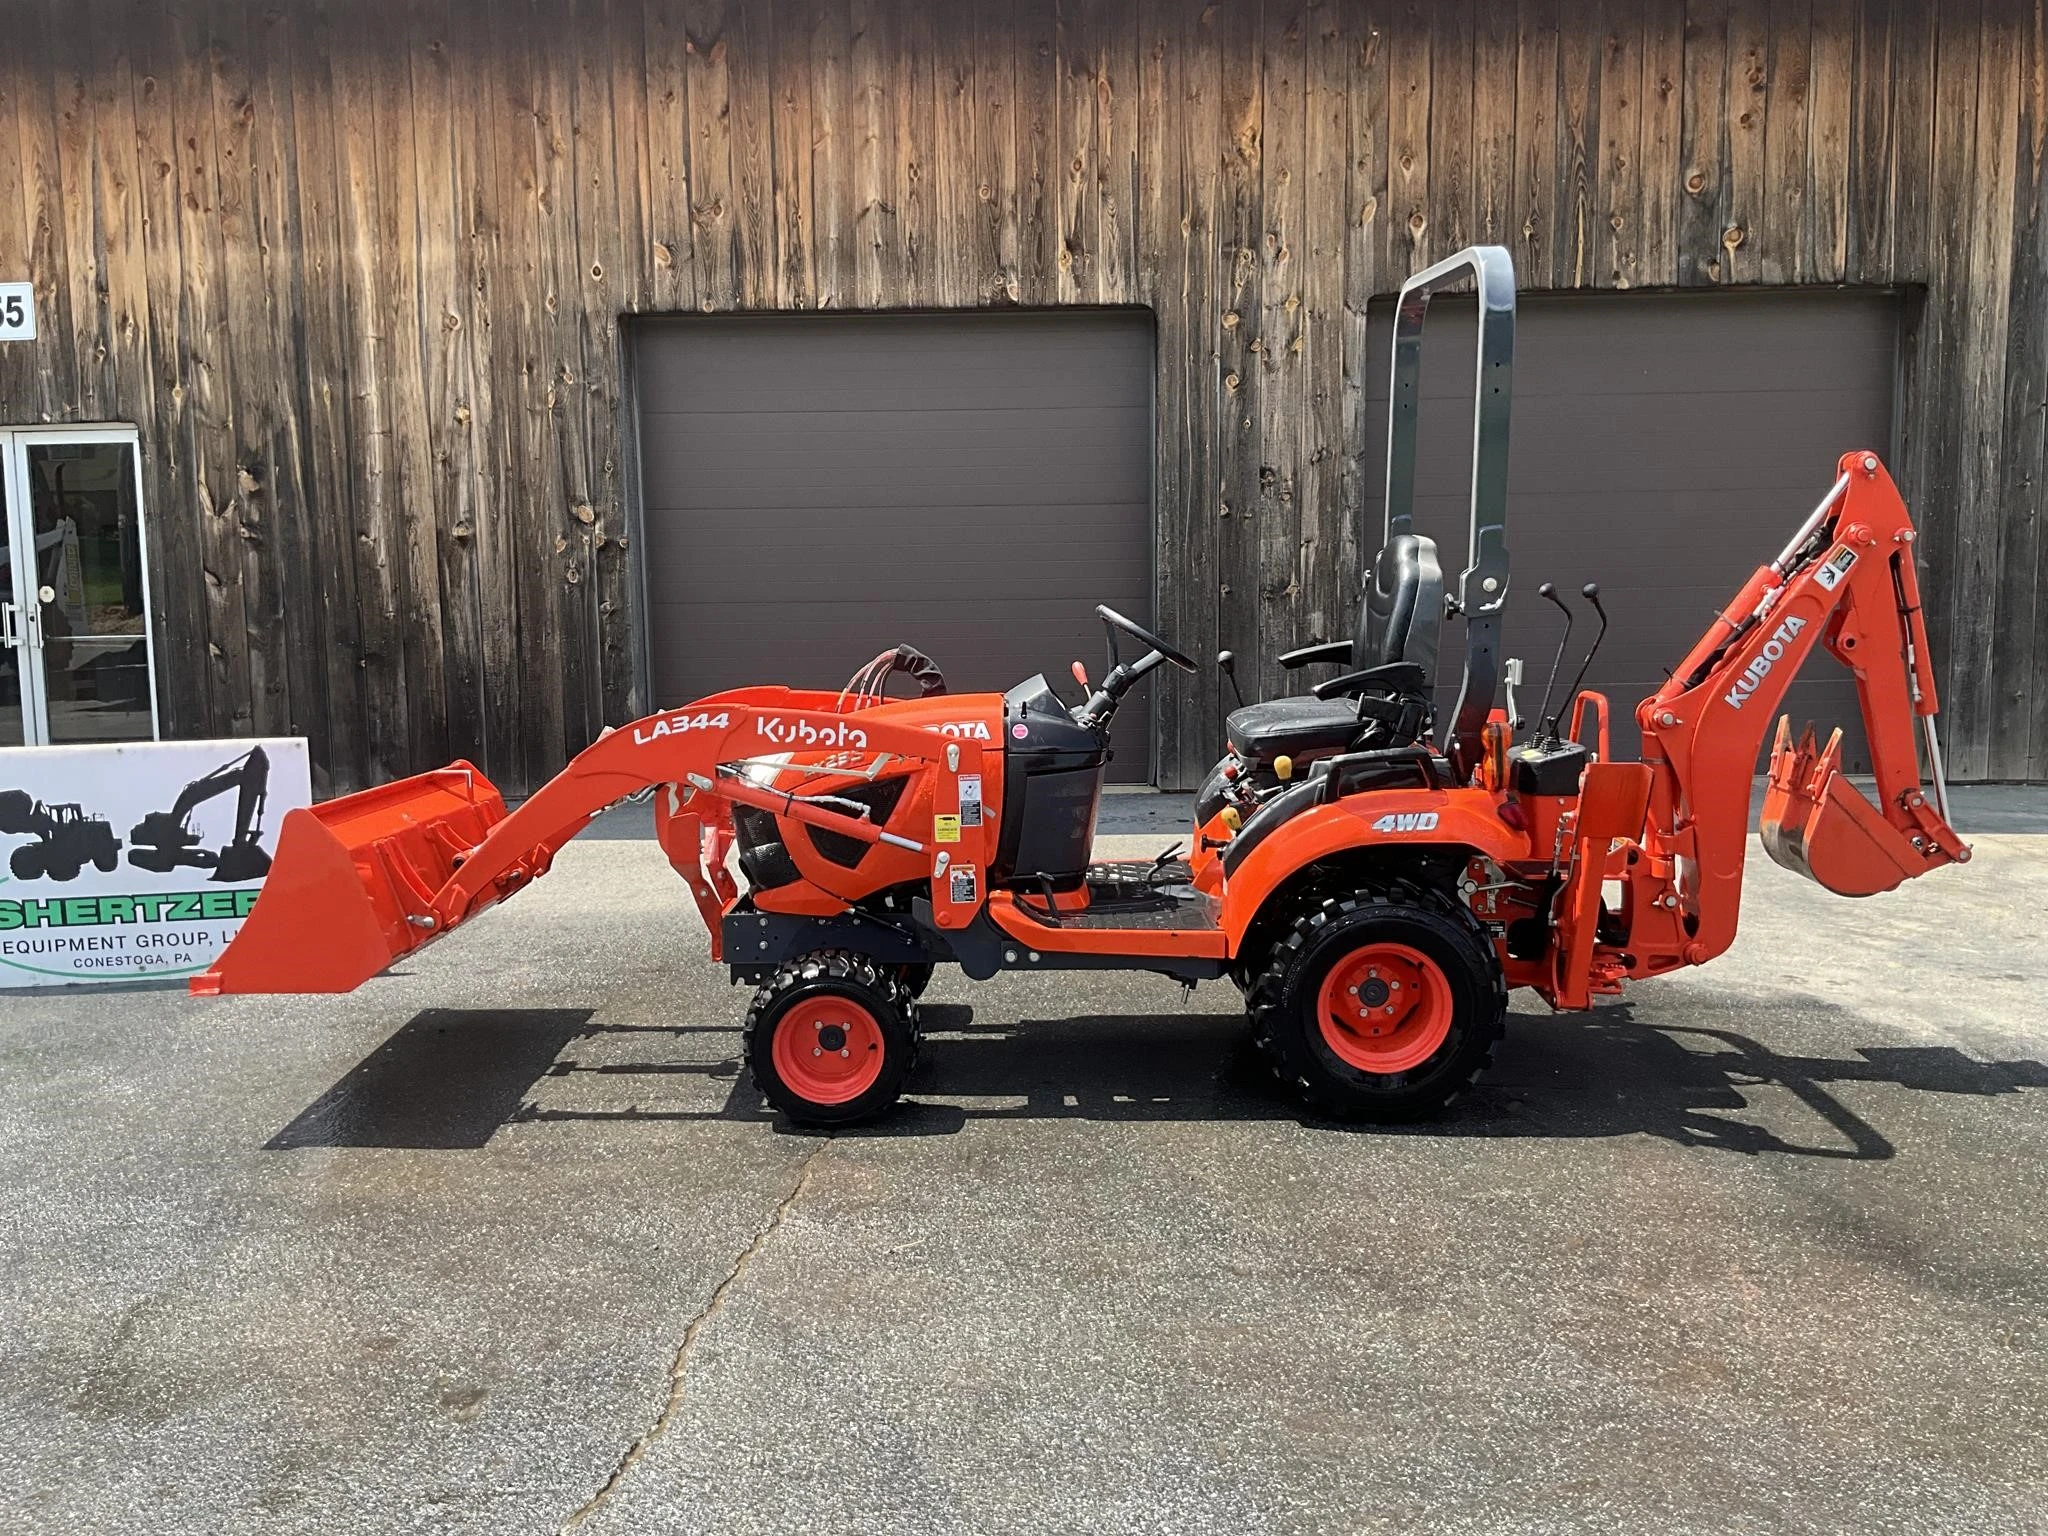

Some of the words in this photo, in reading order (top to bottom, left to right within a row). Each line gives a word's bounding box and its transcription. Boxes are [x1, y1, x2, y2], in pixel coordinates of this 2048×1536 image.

[0, 295, 25, 328] 5
[1723, 615, 1808, 710] KUBOTA
[633, 712, 729, 745] LA344
[757, 716, 867, 748] Kubota
[1371, 812, 1439, 833] 4WD
[3, 935, 127, 955] EQUIPMENT
[136, 931, 213, 948] GROUP,
[73, 954, 169, 968] CONESTOGA,
[174, 953, 192, 963] PA
